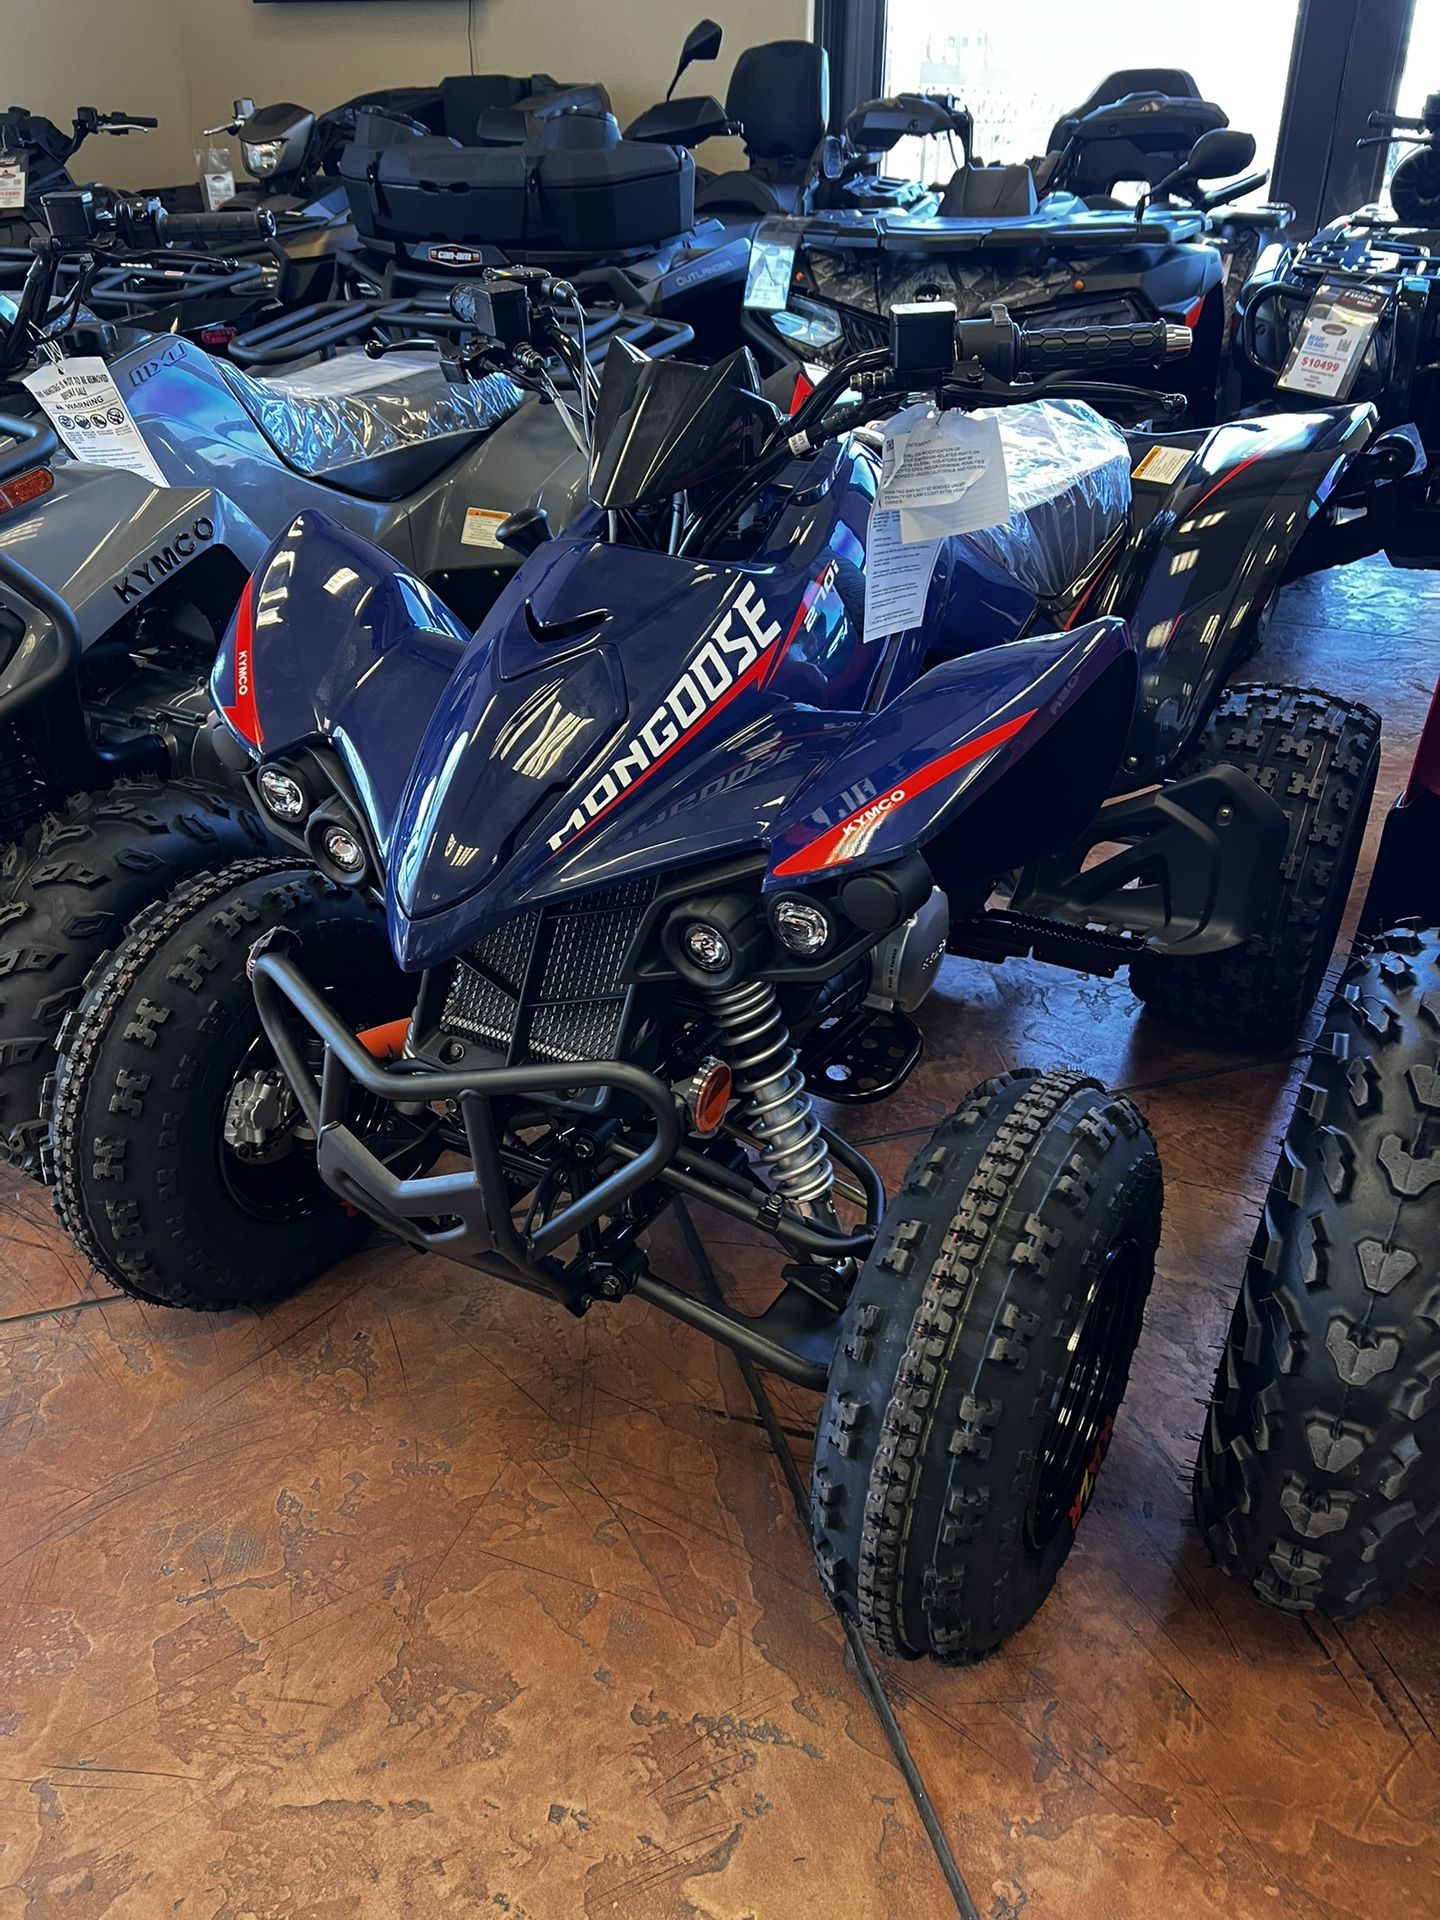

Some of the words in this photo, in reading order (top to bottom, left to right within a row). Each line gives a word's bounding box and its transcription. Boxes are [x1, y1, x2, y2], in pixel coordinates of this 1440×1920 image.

[438, 251, 472, 261] can-am
[675, 260, 733, 287] OUTLANDER
[1301, 356, 1340, 373] $10499
[65, 395, 104, 410] WARNING
[113, 517, 214, 604] KYMCO
[803, 559, 840, 632] 270i
[238, 650, 248, 695] KYMCO
[546, 580, 782, 851] MONGOOSE
[842, 789, 905, 836] KYMCO
